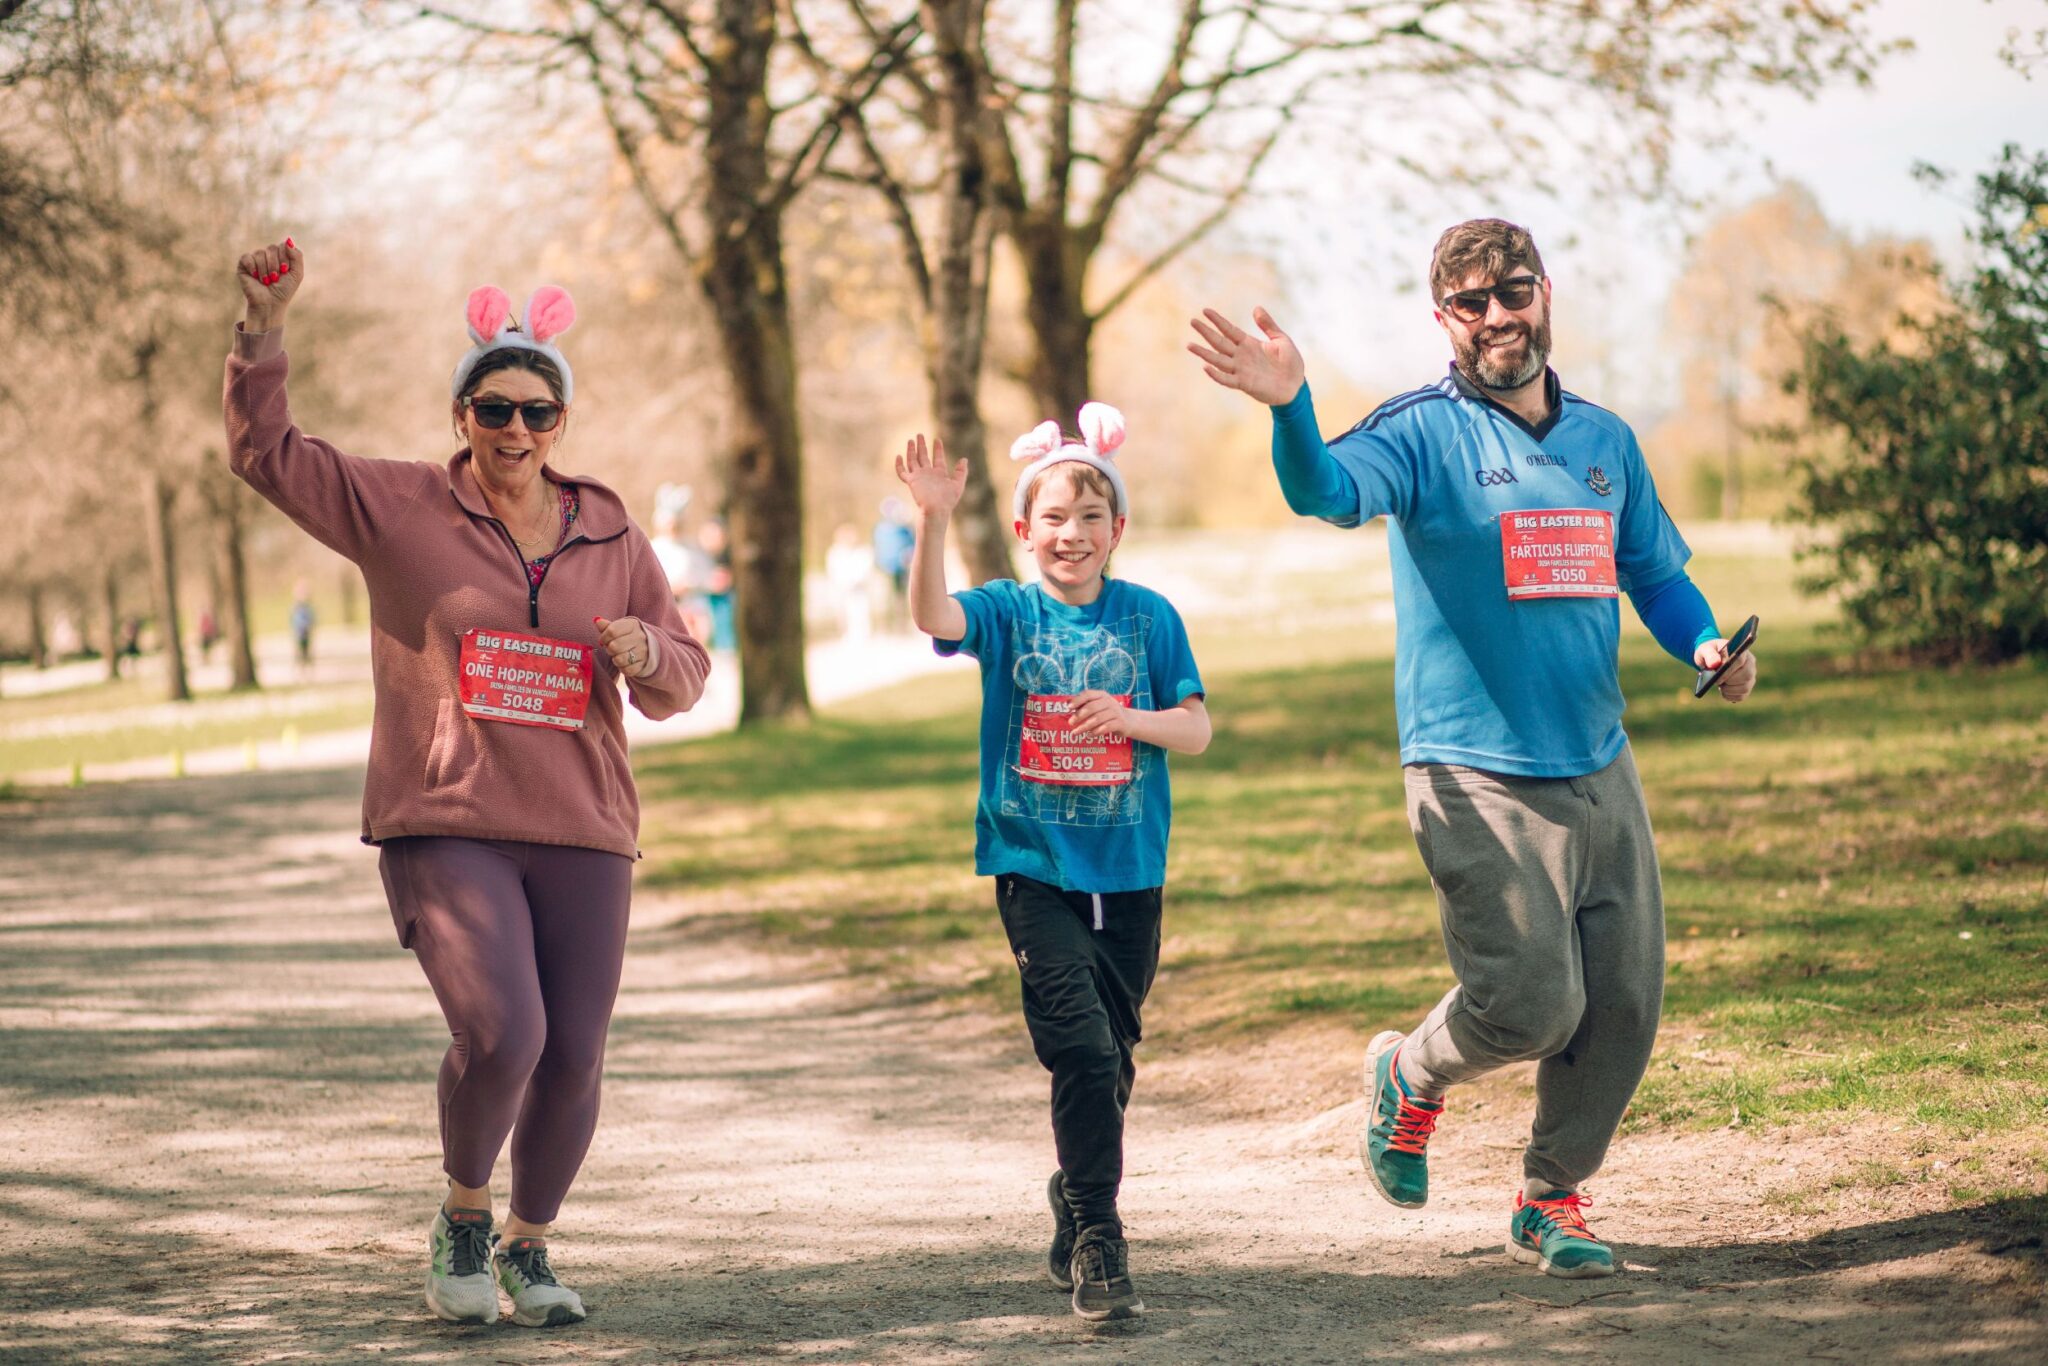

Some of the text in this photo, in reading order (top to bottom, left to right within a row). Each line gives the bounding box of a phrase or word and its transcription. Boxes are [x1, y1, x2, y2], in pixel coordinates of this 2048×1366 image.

[1526, 454, 1568, 467] O'NEILLS
[1475, 467, 1519, 487] GAA
[1514, 515, 1605, 529] BIG EASTER RUN
[1510, 543, 1611, 560] FARTICUS FLUFFYTAIL
[1551, 568, 1587, 582] 5050
[476, 635, 582, 661] BIG EASTER RUN
[465, 662, 584, 692] ONE HOPPY MAMA
[504, 684, 525, 694] FAMILIES
[531, 688, 558, 699] VANCOUVER
[501, 692, 544, 712] 5048
[1026, 700, 1076, 713] BIG EAS
[1022, 727, 1057, 745] SPEEDY
[1052, 746, 1073, 754] FAMILIES
[1080, 746, 1107, 754] VANCOUVER
[1052, 756, 1094, 770] 5049
